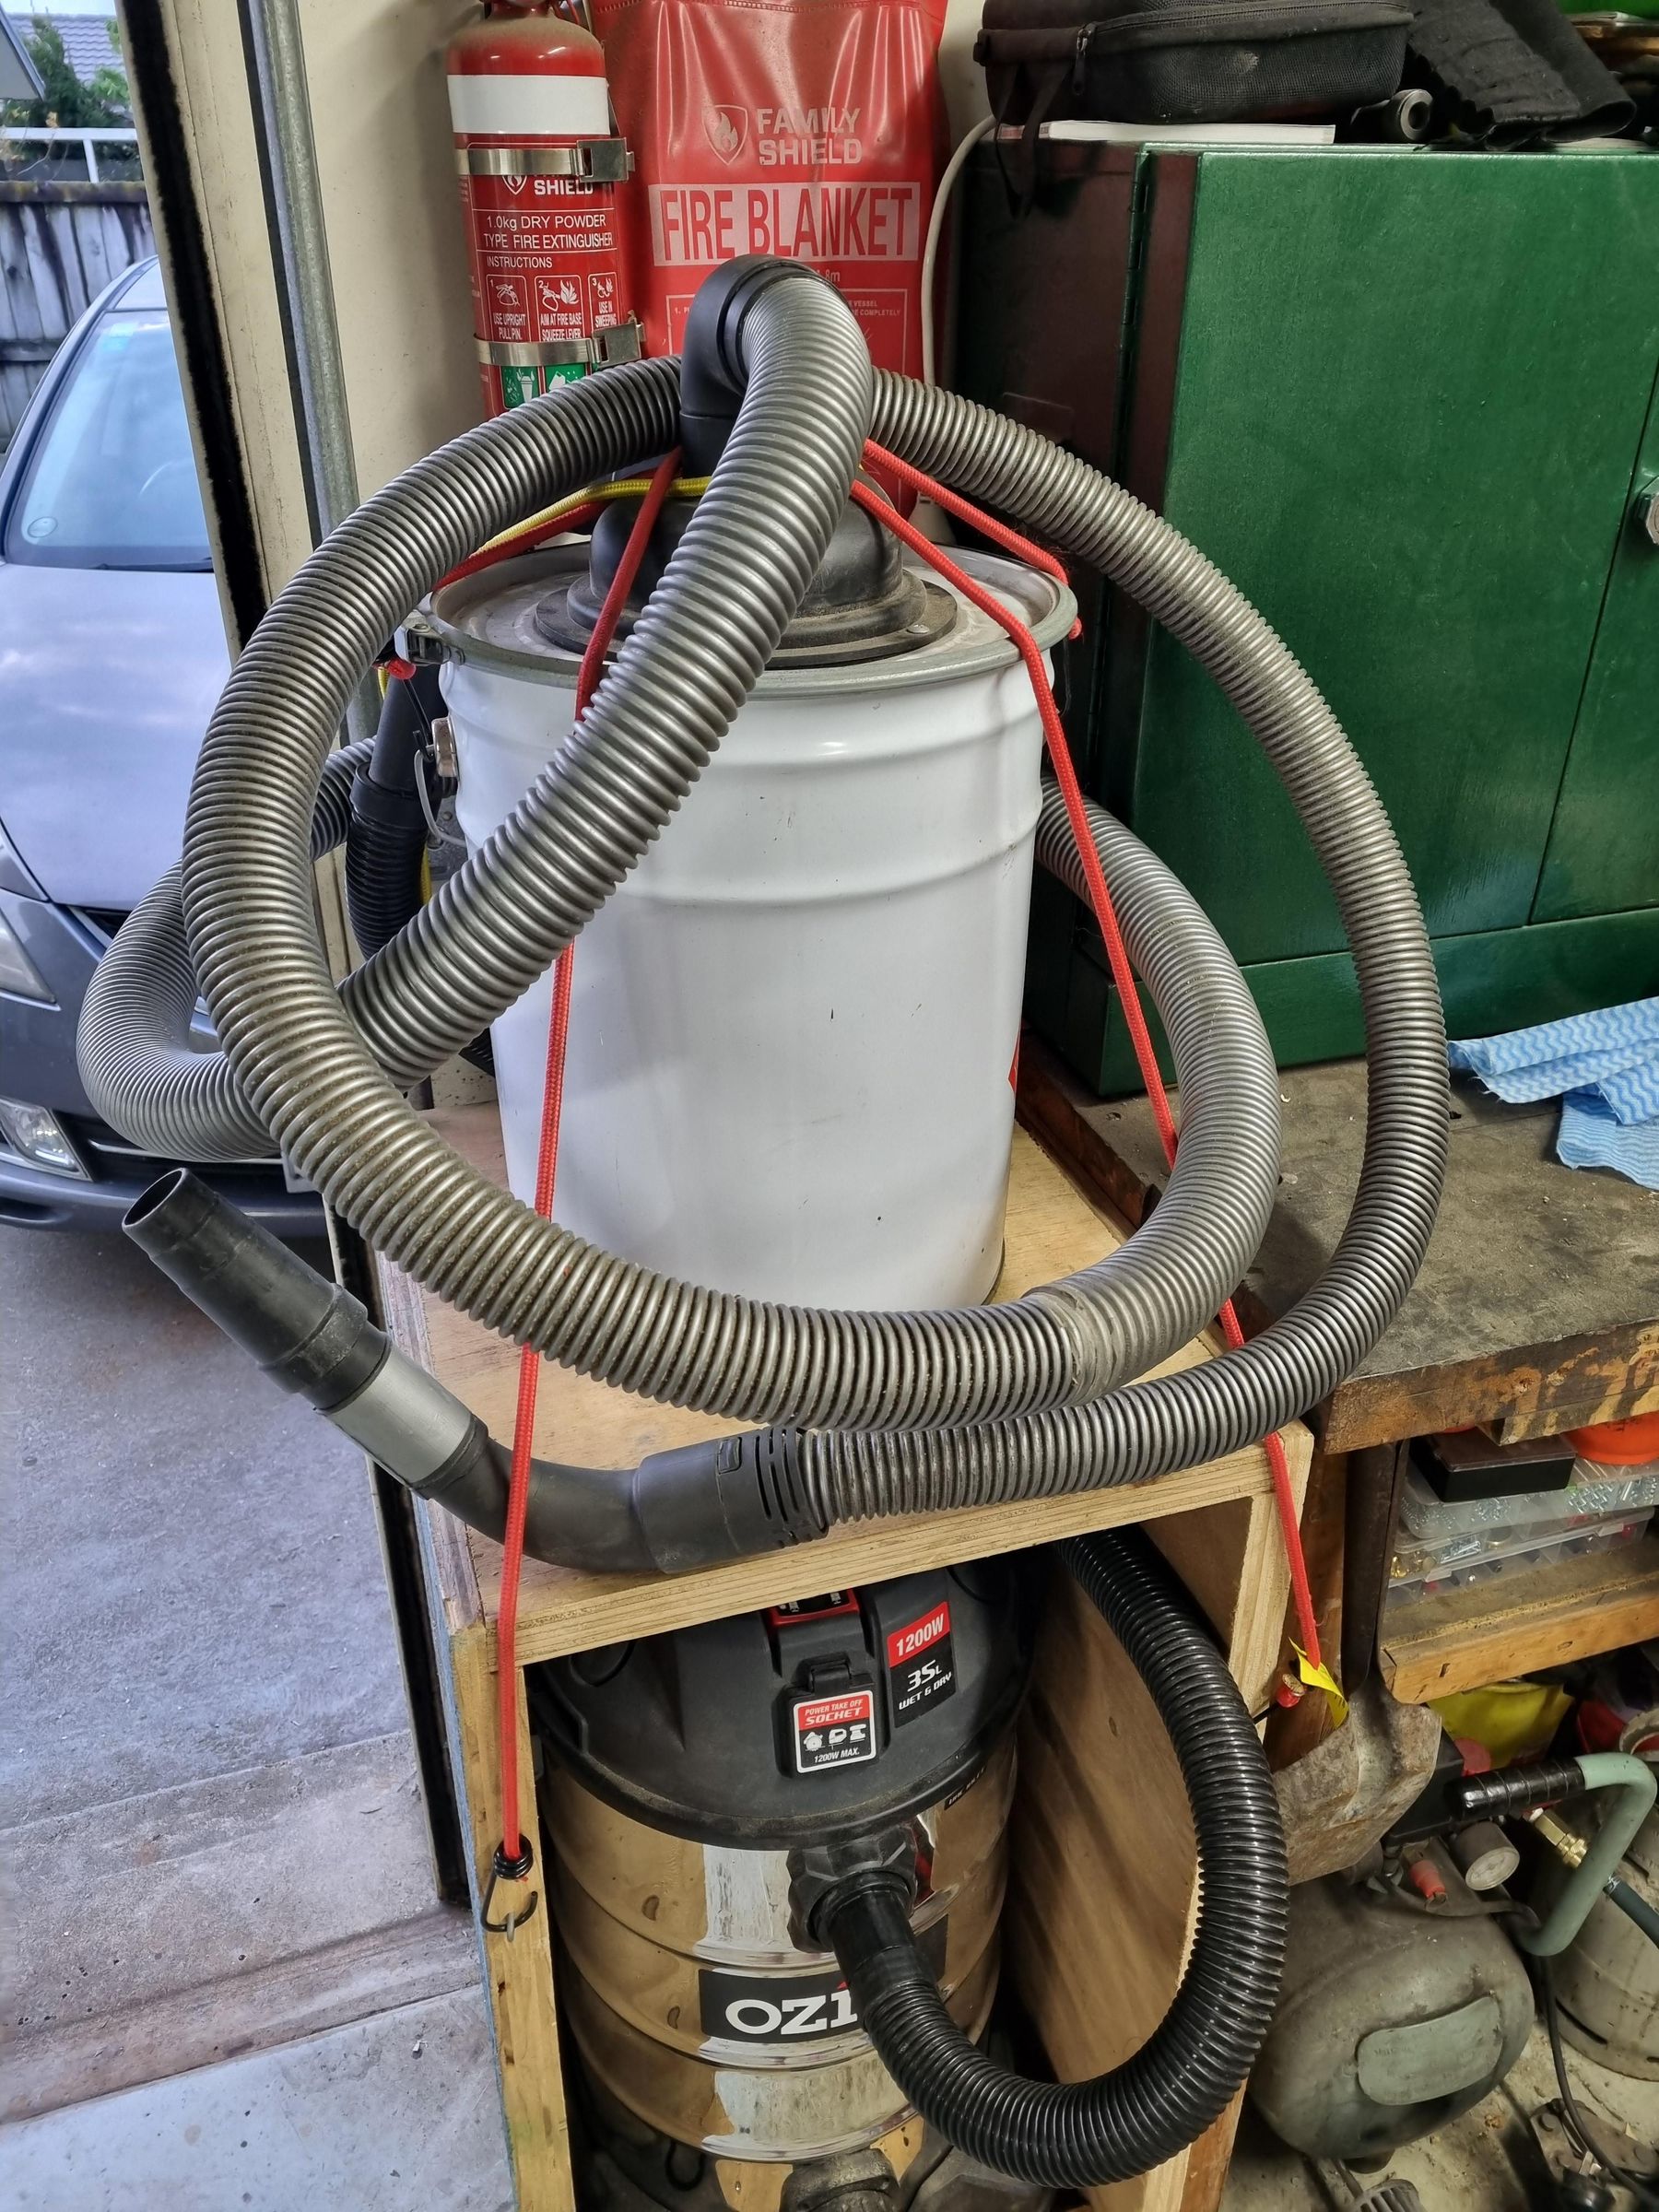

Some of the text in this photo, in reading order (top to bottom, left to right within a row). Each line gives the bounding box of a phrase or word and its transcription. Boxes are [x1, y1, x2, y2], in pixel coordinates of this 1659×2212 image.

[757, 107, 862, 135] FAMILY
[759, 138, 863, 166] SHIELD
[534, 179, 594, 195] SHIELD
[487, 214, 606, 231] 1.0kg DRY POWDER
[659, 187, 913, 261] FIRE BLANKET
[484, 231, 614, 249] TYPE FIRE EXTINGUISHER
[486, 255, 553, 269] INSTRUCTIONS
[489, 279, 494, 288] 1
[538, 280, 544, 288] 2
[592, 277, 597, 287] 3
[493, 312, 526, 326] USE UPRIGHT
[540, 312, 582, 326] AIM AT FIRE BASE
[499, 327, 512, 340] PULL
[541, 327, 582, 342] SQUEEZE LEVER
[896, 1613, 945, 1657] 1200W
[907, 1659, 942, 1692] 35L
[899, 1671, 952, 1710] WET & DRY
[805, 1699, 864, 1716] POWER TAKE OFF
[814, 1747, 860, 1763] 1200W MAX.
